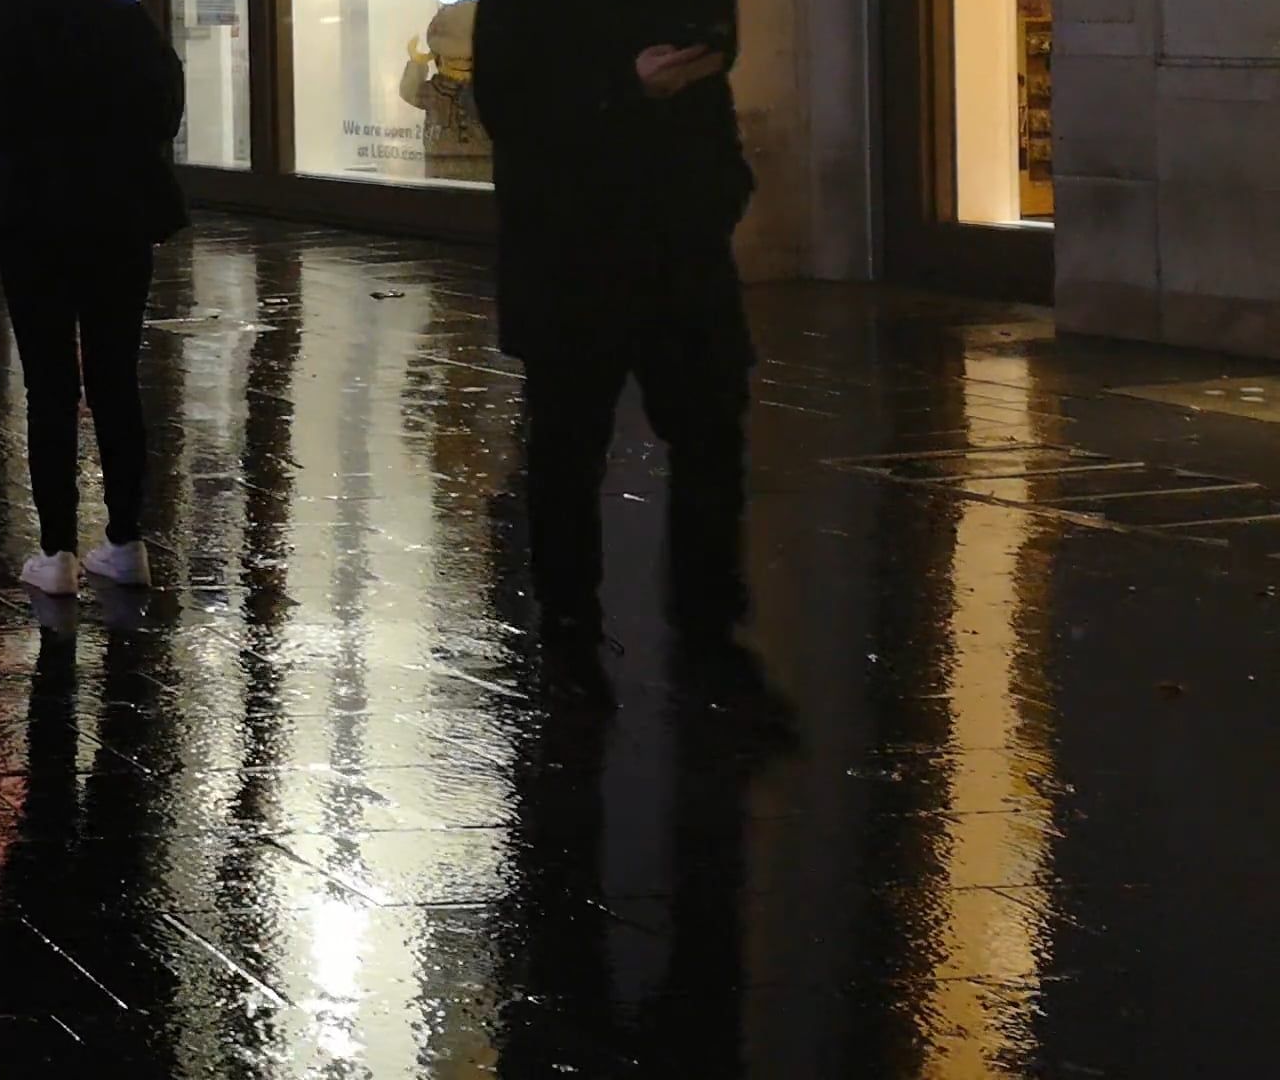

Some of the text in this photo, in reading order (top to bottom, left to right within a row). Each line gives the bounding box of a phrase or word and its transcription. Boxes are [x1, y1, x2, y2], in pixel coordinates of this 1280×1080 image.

[343, 120, 360, 136] We
[363, 125, 382, 137] are
[384, 126, 413, 140] open
[357, 146, 369, 158] at
